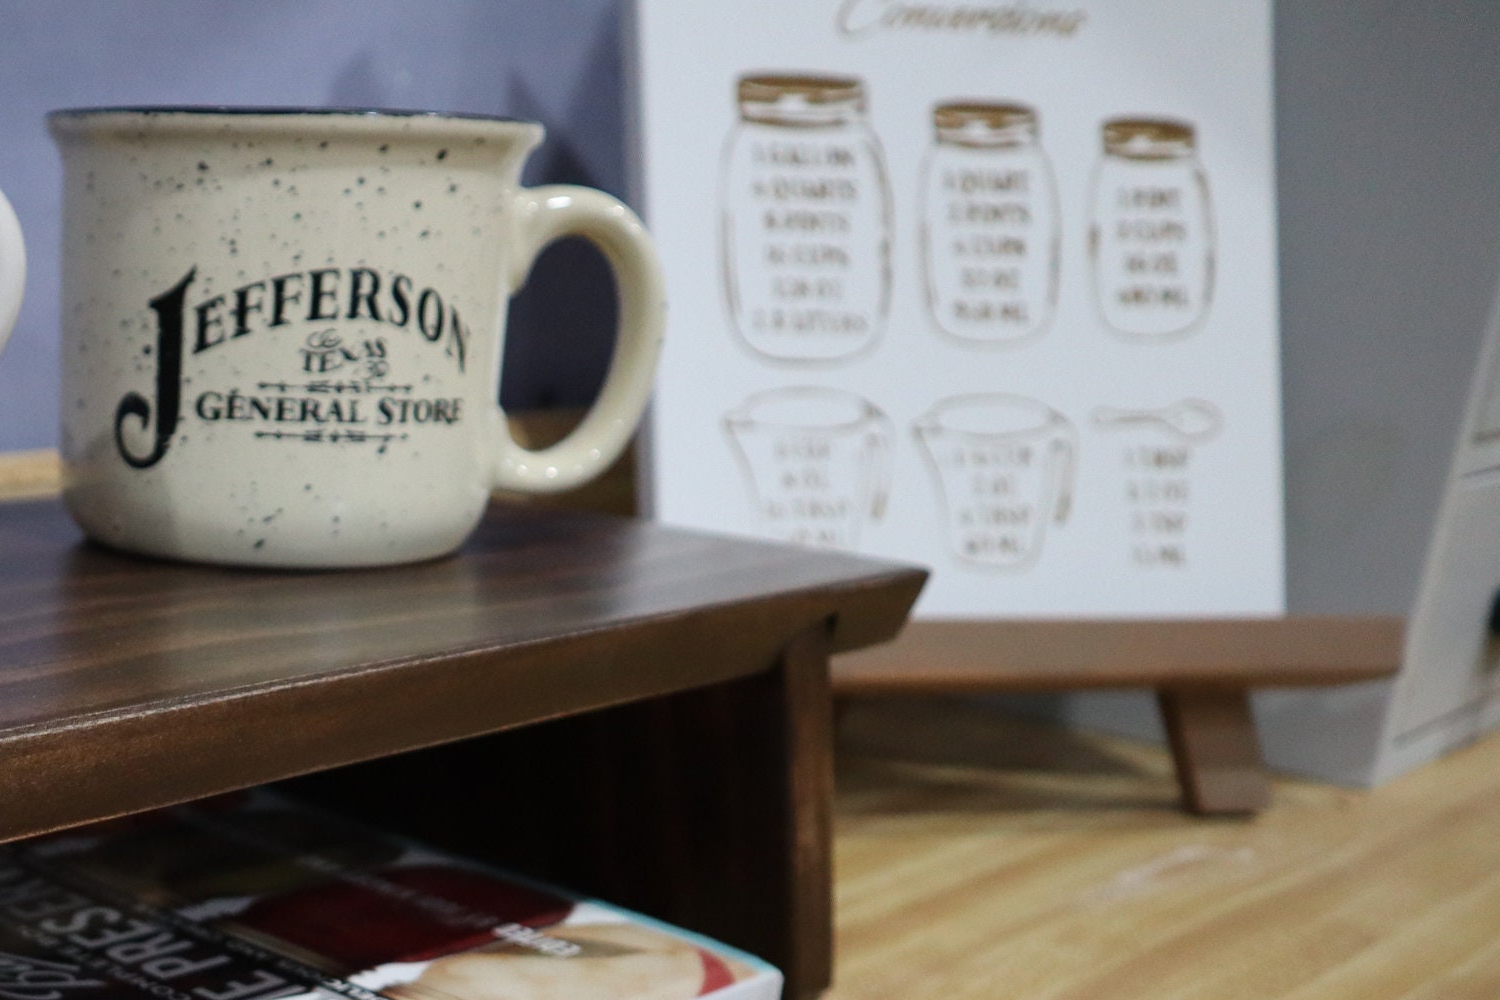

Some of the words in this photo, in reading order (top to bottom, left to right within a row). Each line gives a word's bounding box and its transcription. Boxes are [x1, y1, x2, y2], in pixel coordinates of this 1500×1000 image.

[115, 264, 471, 470] JEFFERSON
[195, 391, 369, 424] GENERAL
[378, 397, 465, 426] STORE
